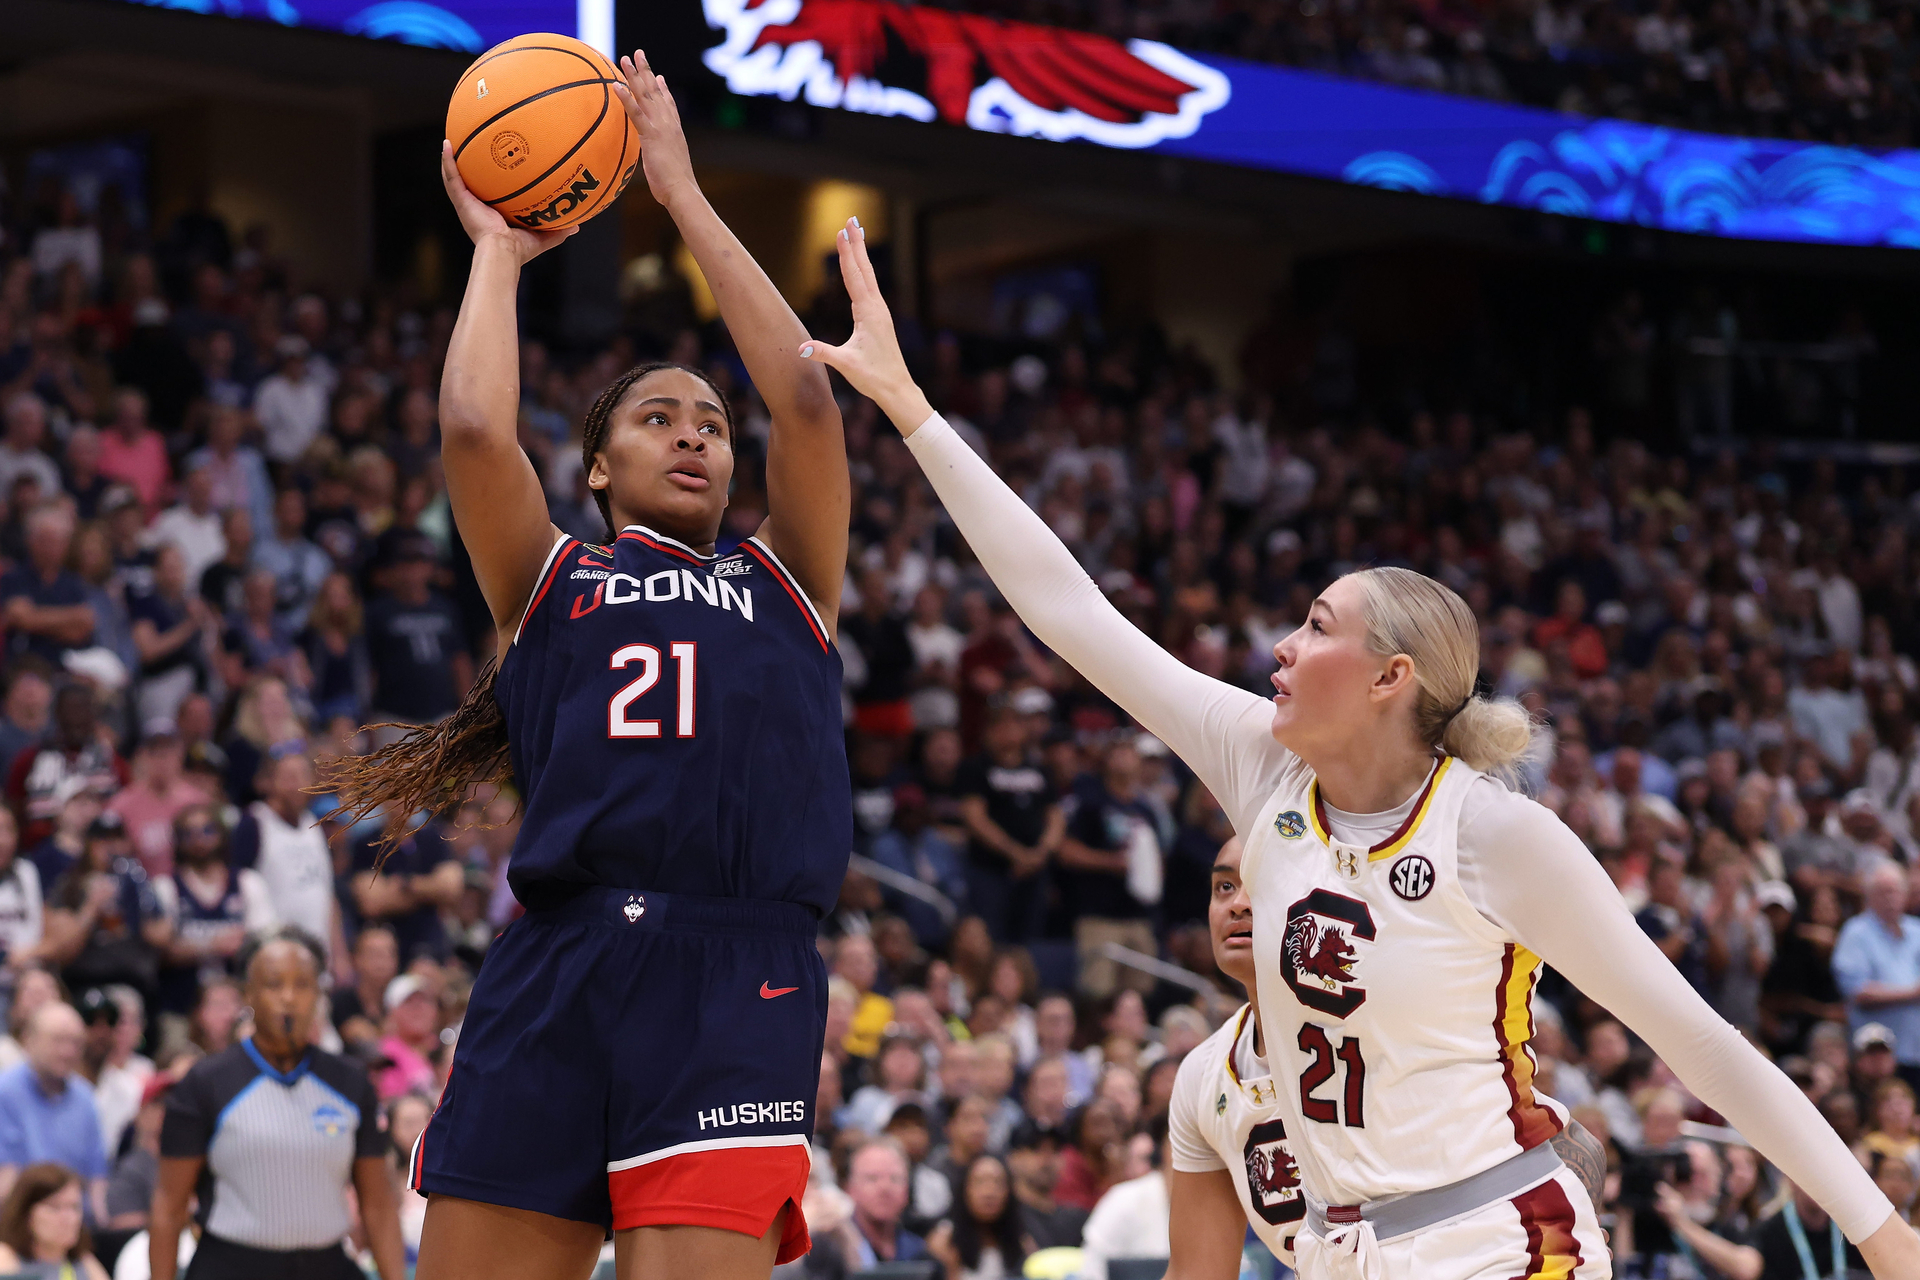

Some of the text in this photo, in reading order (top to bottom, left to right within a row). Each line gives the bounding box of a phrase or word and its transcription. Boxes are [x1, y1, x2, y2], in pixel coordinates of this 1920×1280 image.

[553, 163, 584, 194] OFFICIAL
[513, 168, 601, 227] NCAA
[531, 194, 554, 209] GAME
[712, 564, 754, 576] EAST
[714, 559, 743, 570] BIG
[569, 568, 754, 623] UCONN
[607, 640, 698, 739] 21
[1393, 856, 1432, 897] SEC
[1297, 1021, 1366, 1129] 21
[697, 1100, 805, 1131] HUSKIES
